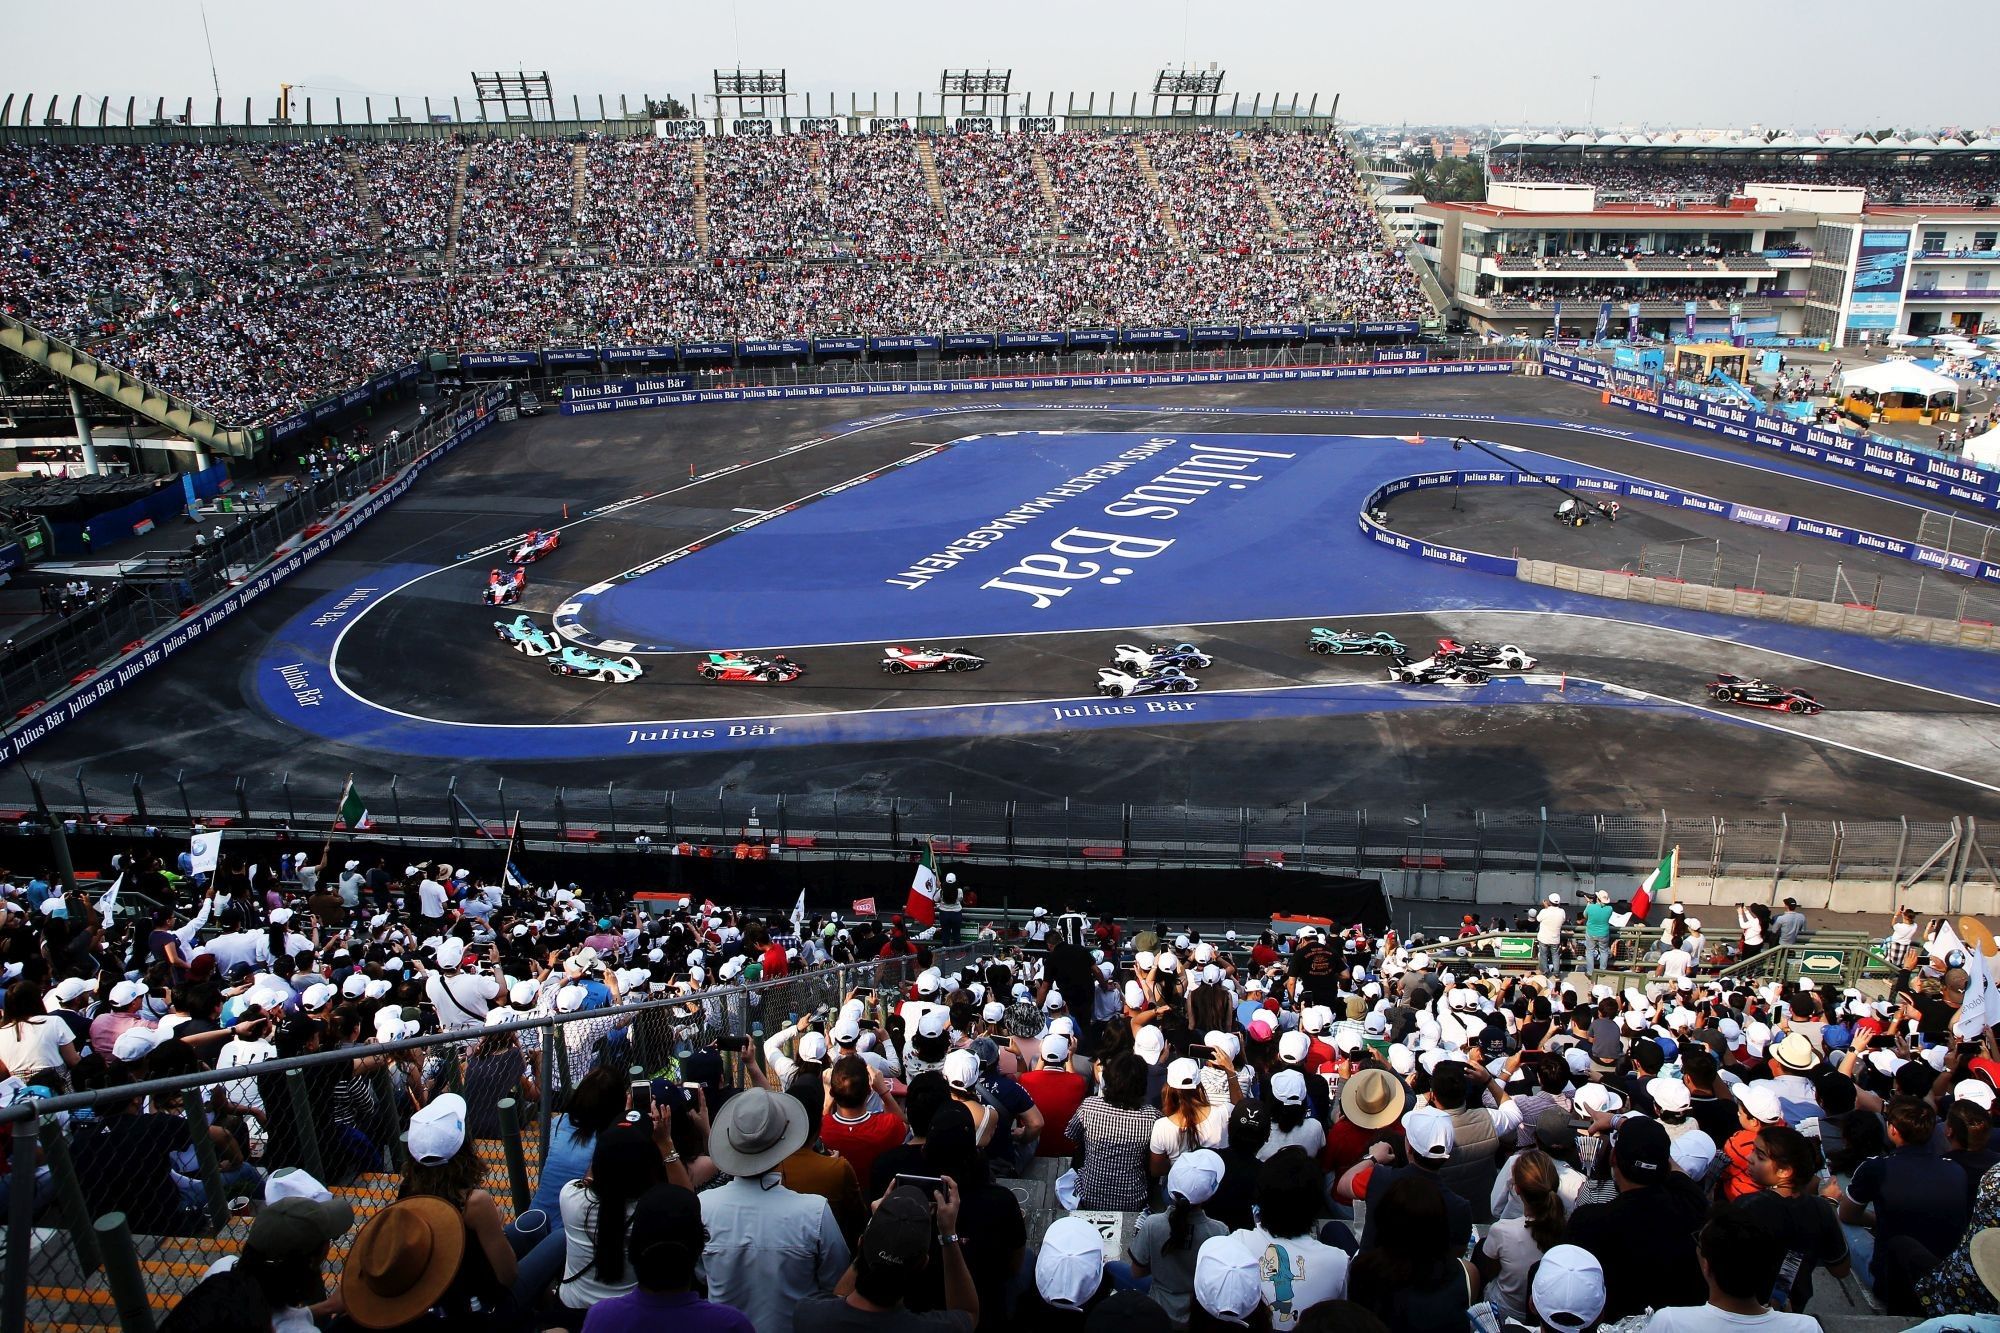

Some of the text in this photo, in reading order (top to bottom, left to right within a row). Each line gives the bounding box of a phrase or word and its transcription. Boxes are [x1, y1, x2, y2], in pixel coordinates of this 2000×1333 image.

[1379, 351, 1421, 360] Julius Bär
[1544, 352, 1572, 367] Julius Bär
[636, 379, 685, 393] Julius Bär
[992, 382, 1012, 390] Julius
[1072, 379, 1092, 387] Julius
[1150, 376, 1169, 384] Julius
[1636, 374, 1648, 386] Bär
[572, 385, 622, 399] Julius Bär
[743, 390, 765, 399] Julius
[828, 387, 849, 395] Julius
[910, 384, 931, 392] Julius
[658, 396, 680, 404] Julius
[1662, 393, 1699, 410] Julius Bär
[572, 404, 595, 413] Julius
[1707, 404, 1746, 422] Julius Bär
[1693, 418, 1706, 426] Julius
[1755, 416, 1797, 435] Julius Bär
[1724, 426, 1738, 435] Julius
[1756, 434, 1772, 444] Julius
[1807, 429, 1854, 450] Julius Bär
[1790, 443, 1806, 453] Julius
[1864, 444, 1915, 465] Julius Bär
[1826, 453, 1843, 463] Julius
[1864, 463, 1882, 474] Julius
[1927, 460, 1986, 484] Julius Bär
[1418, 477, 1438, 486] Julius
[1465, 474, 1487, 482] Julius
[1576, 478, 1618, 490] Julius Bär
[1906, 474, 1925, 485] Julius
[1630, 486, 1669, 500] Julius Bär
[1950, 486, 1970, 498] Julius
[1682, 496, 1724, 512] Julius Bär
[886, 438, 1177, 590] SWISS WEALTH MANAGEMENT
[1737, 509, 1781, 524] Julius Bär
[980, 443, 1296, 609] Julius Bär
[1797, 521, 1843, 538] Julius Bär
[1376, 531, 1410, 550] Julius Bär
[1858, 534, 1905, 552] Julius Bär
[302, 546, 320, 563] Julius
[1422, 546, 1467, 563] Julius Bär
[1918, 550, 1970, 570] Julius Bär
[272, 566, 290, 584] Julius
[240, 578, 270, 607] Julius Bär
[310, 588, 379, 627] Julius Bär
[204, 601, 237, 630] Julius Bär
[163, 624, 201, 657] Julius Bär
[118, 650, 159, 686] Julius Bär
[273, 662, 324, 707] Julius Bär
[69, 679, 114, 718] Julius Bär
[1052, 701, 1197, 720] Julius Bär
[13, 711, 64, 754] Julius Bär
[627, 724, 783, 744] Julius Bär
